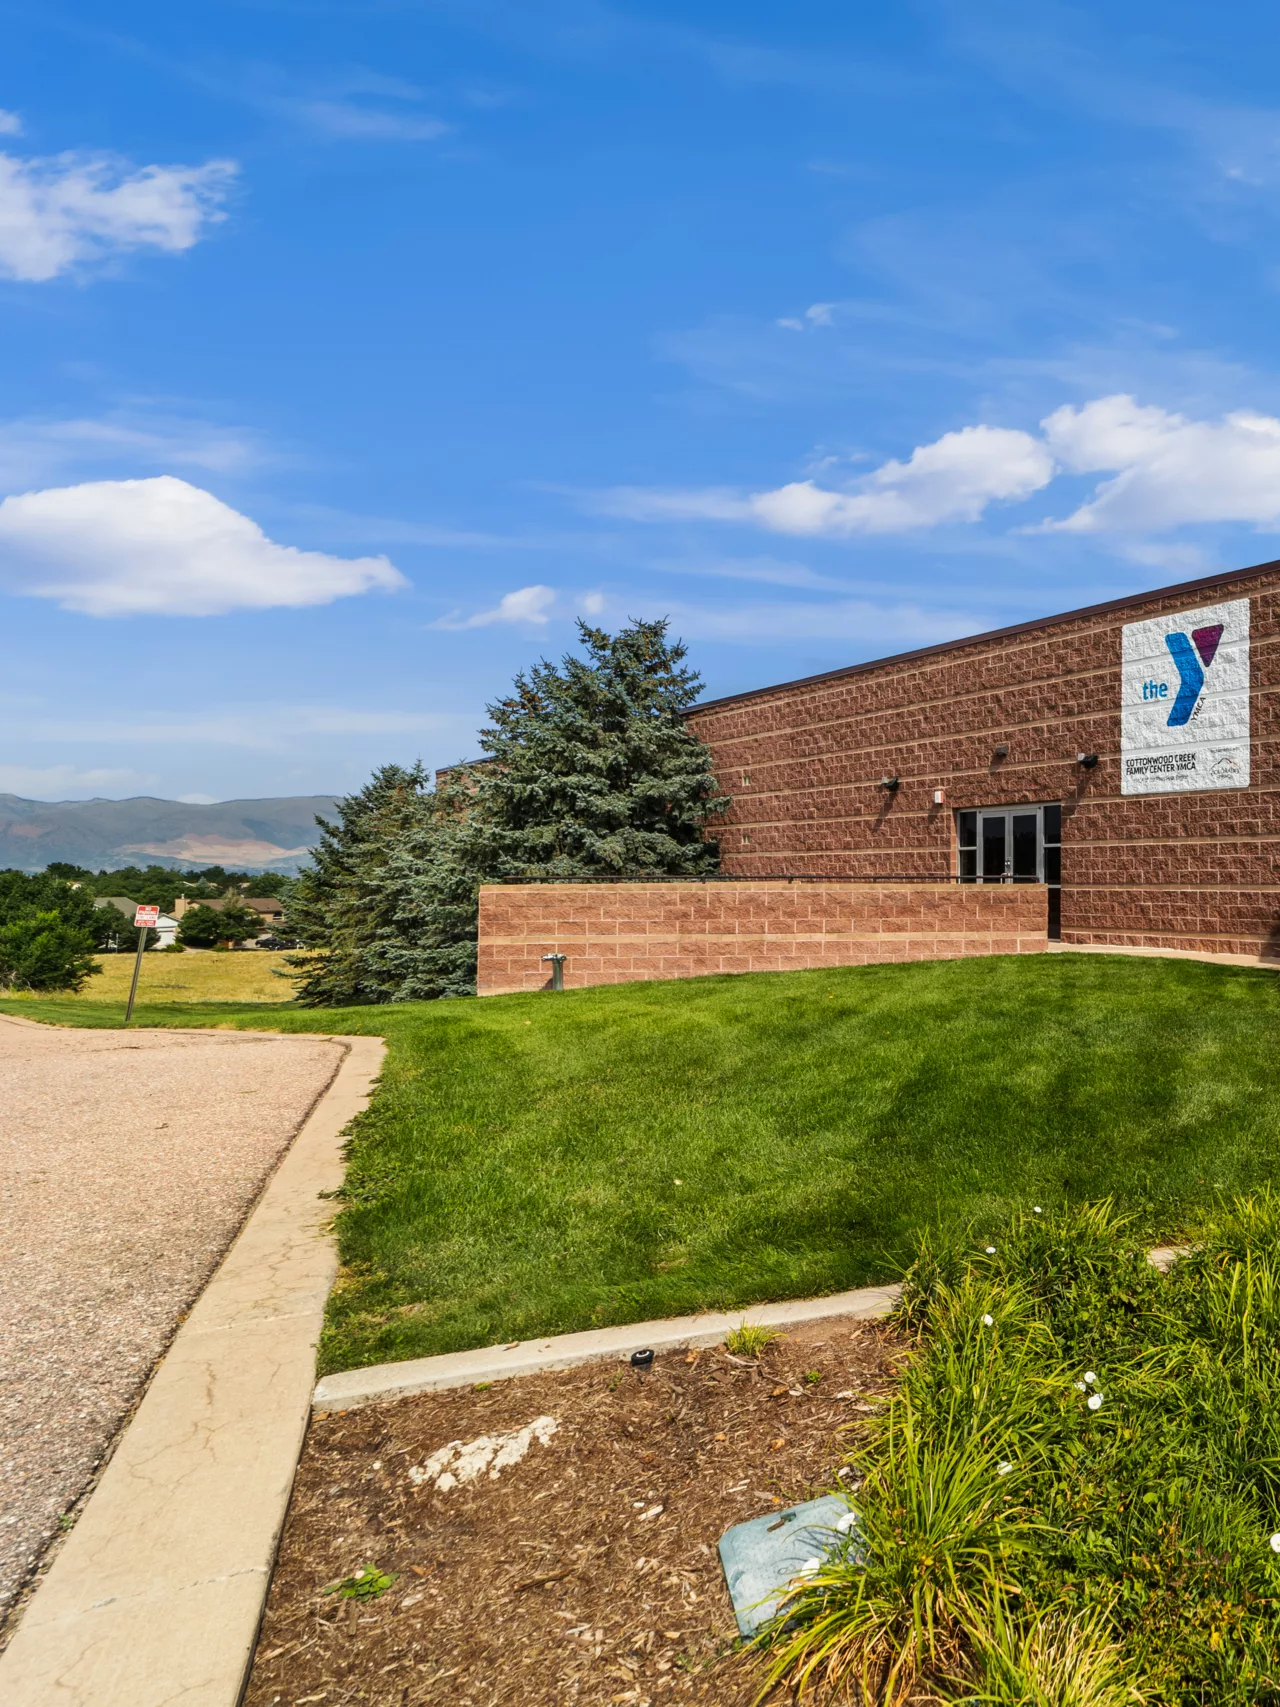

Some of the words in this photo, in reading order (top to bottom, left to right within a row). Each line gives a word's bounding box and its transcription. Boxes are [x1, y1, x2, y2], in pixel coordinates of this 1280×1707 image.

[1142, 680, 1168, 700] the
[1191, 697, 1206, 721] YMCA
[1126, 755, 1174, 767] COTTONWOOD
[1174, 752, 1196, 762] CREEK
[1126, 765, 1149, 775] FAMILY
[1149, 763, 1175, 773] CENTER
[1176, 761, 1196, 771] YMCA
